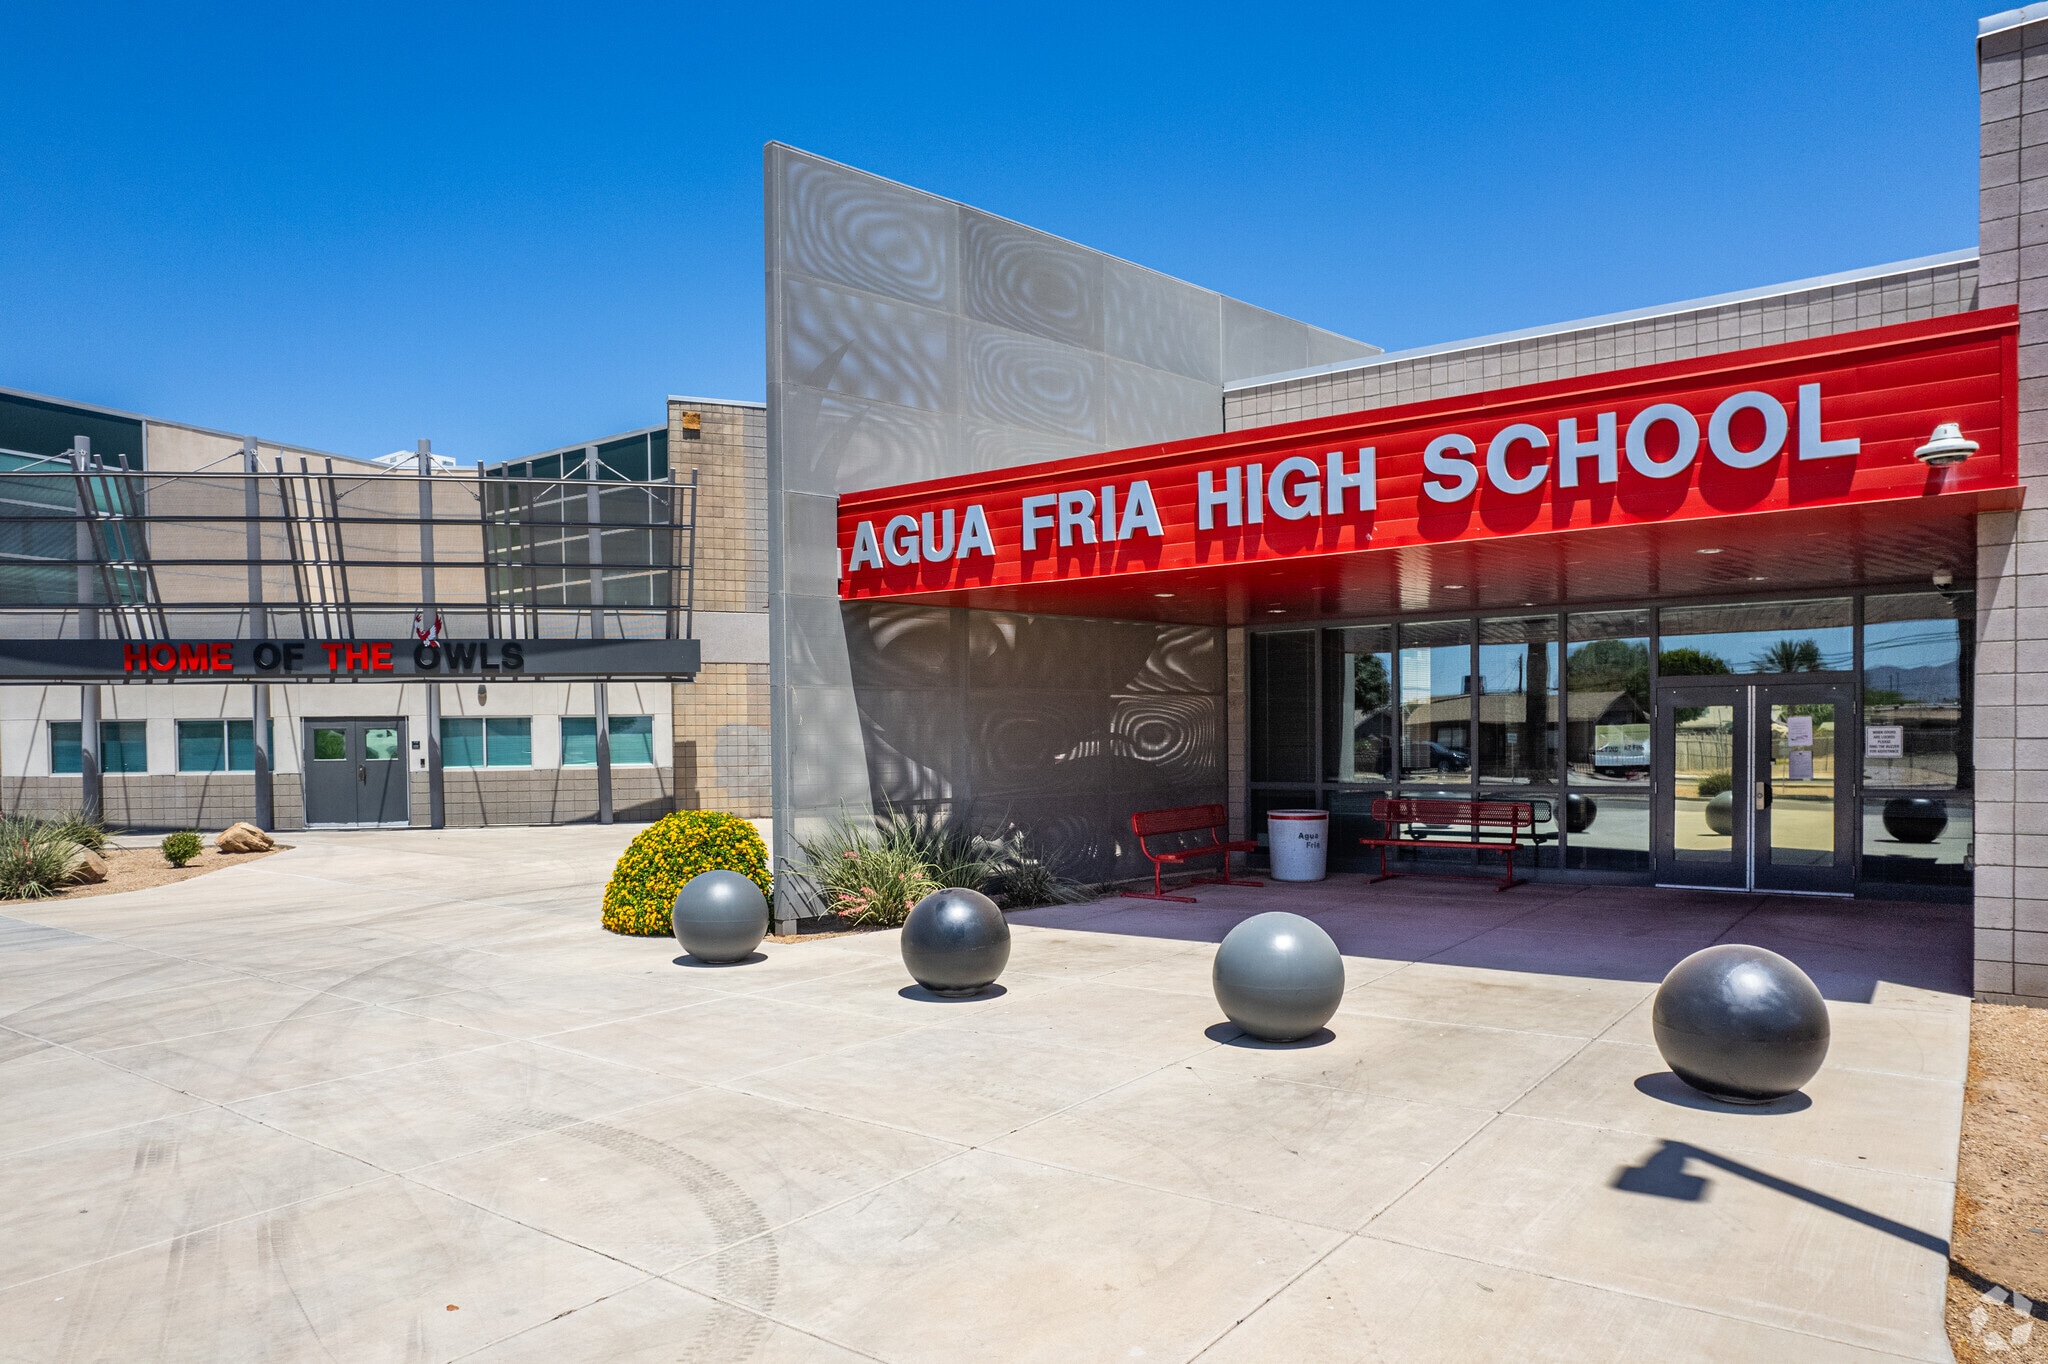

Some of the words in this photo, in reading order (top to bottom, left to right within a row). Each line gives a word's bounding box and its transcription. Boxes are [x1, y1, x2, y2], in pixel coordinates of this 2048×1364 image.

[849, 504, 996, 572] AGUA
[1022, 479, 1164, 551] FRIA
[1197, 446, 1377, 531] HIGH
[1423, 382, 1861, 503] SCHOOL
[123, 642, 234, 671] HOME
[252, 642, 305, 671] OF
[321, 642, 394, 671] THE
[413, 642, 525, 671] OWLS
[1298, 832, 1319, 840] Agua
